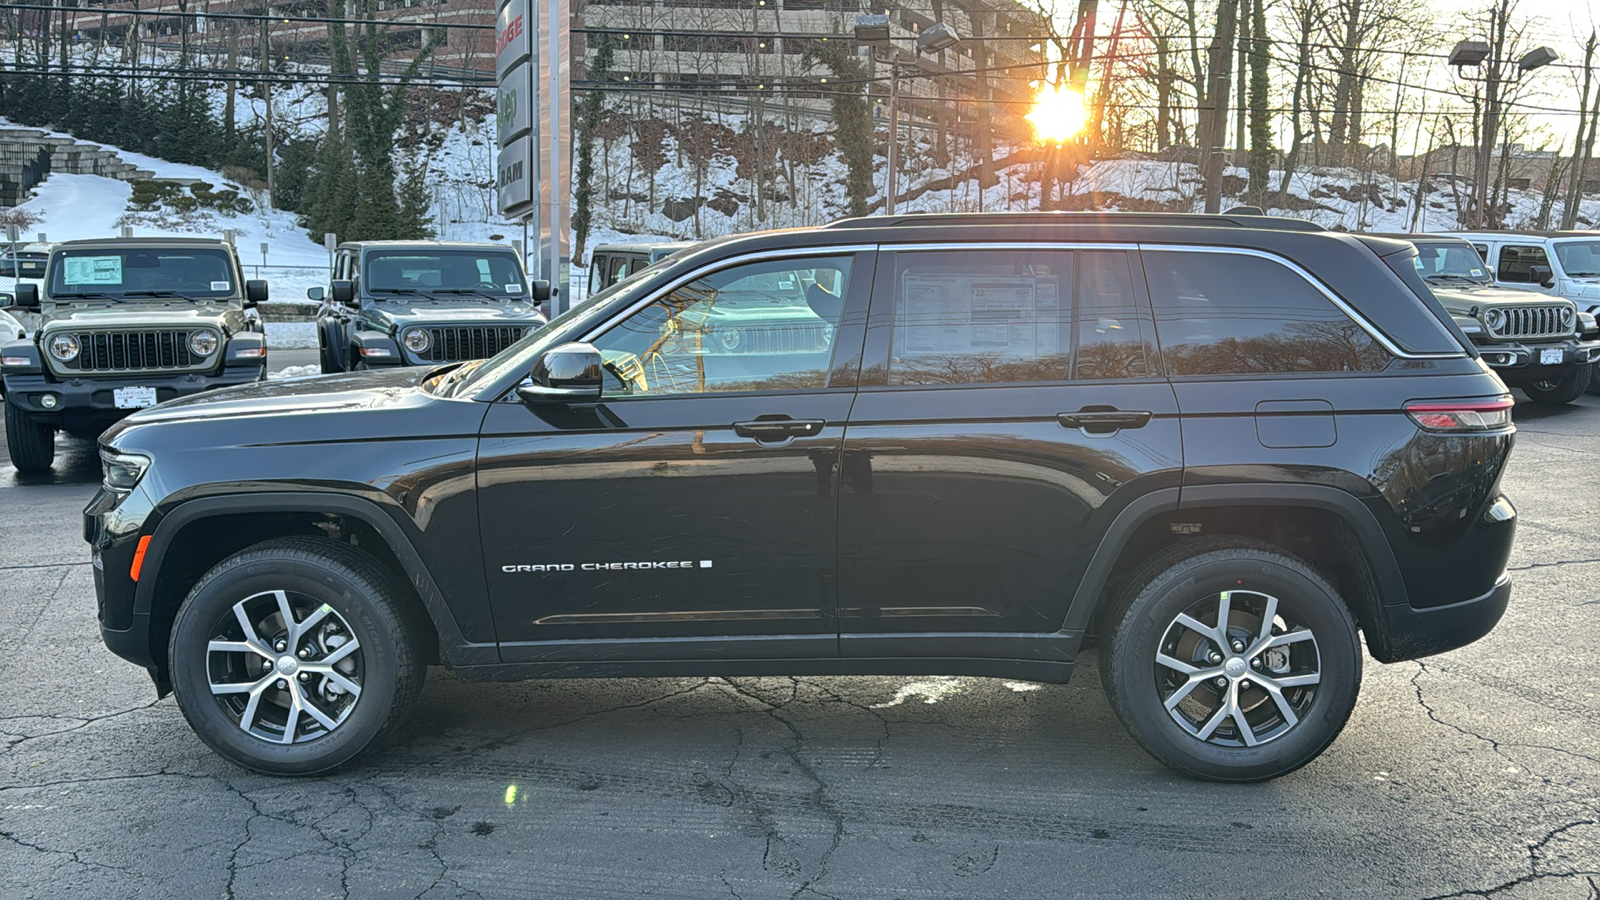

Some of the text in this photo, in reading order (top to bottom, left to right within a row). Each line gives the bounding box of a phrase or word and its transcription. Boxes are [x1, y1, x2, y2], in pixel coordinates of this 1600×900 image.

[501, 160, 523, 188] RAM
[501, 561, 693, 573] GRAND CHEROKEE
